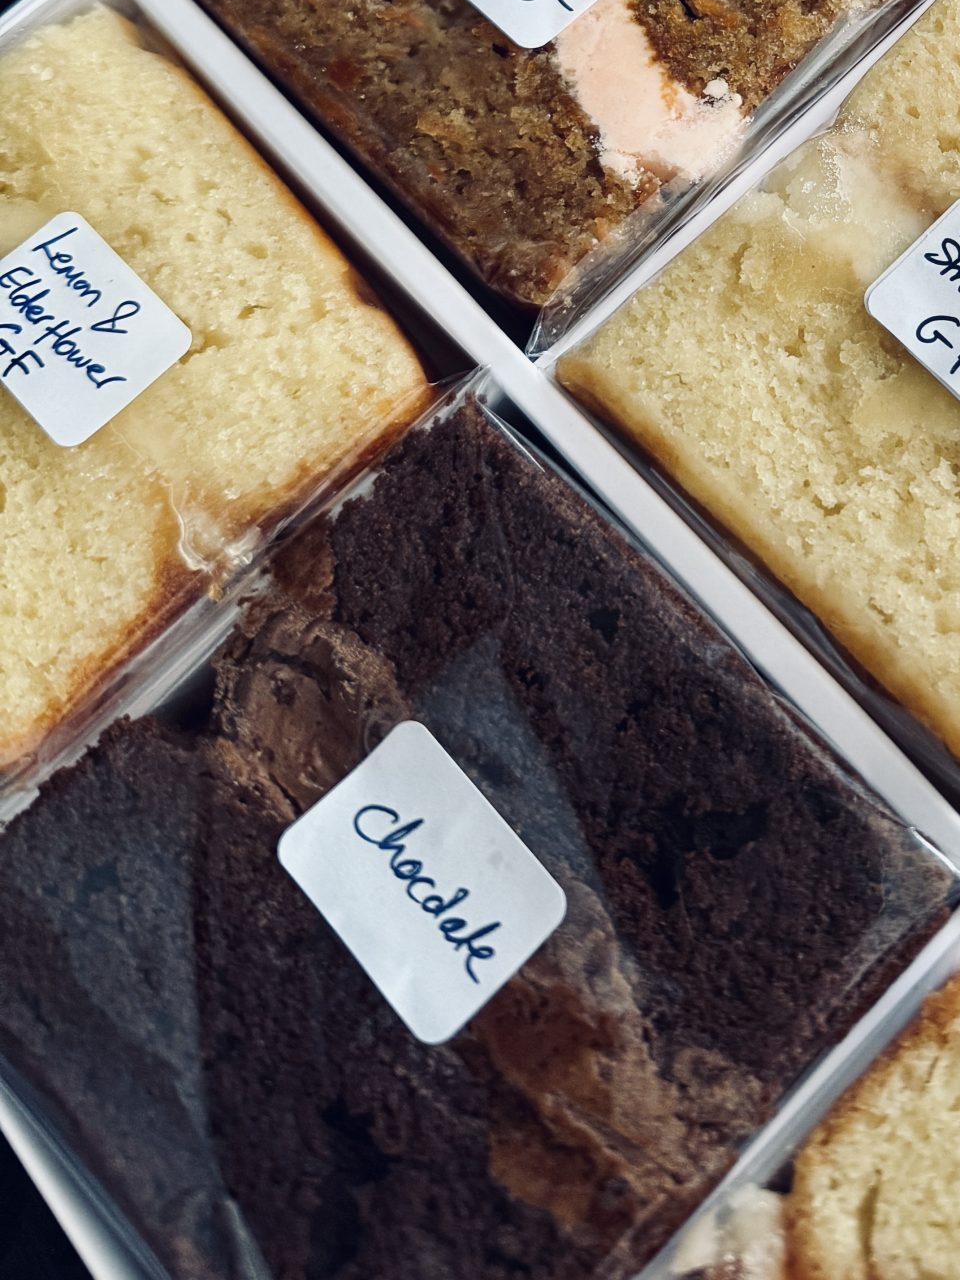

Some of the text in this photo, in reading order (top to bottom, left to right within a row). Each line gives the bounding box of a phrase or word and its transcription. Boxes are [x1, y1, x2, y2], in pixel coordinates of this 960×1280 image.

[32, 227, 143, 337] Lemon &
[353, 803, 500, 984] Chocolate
